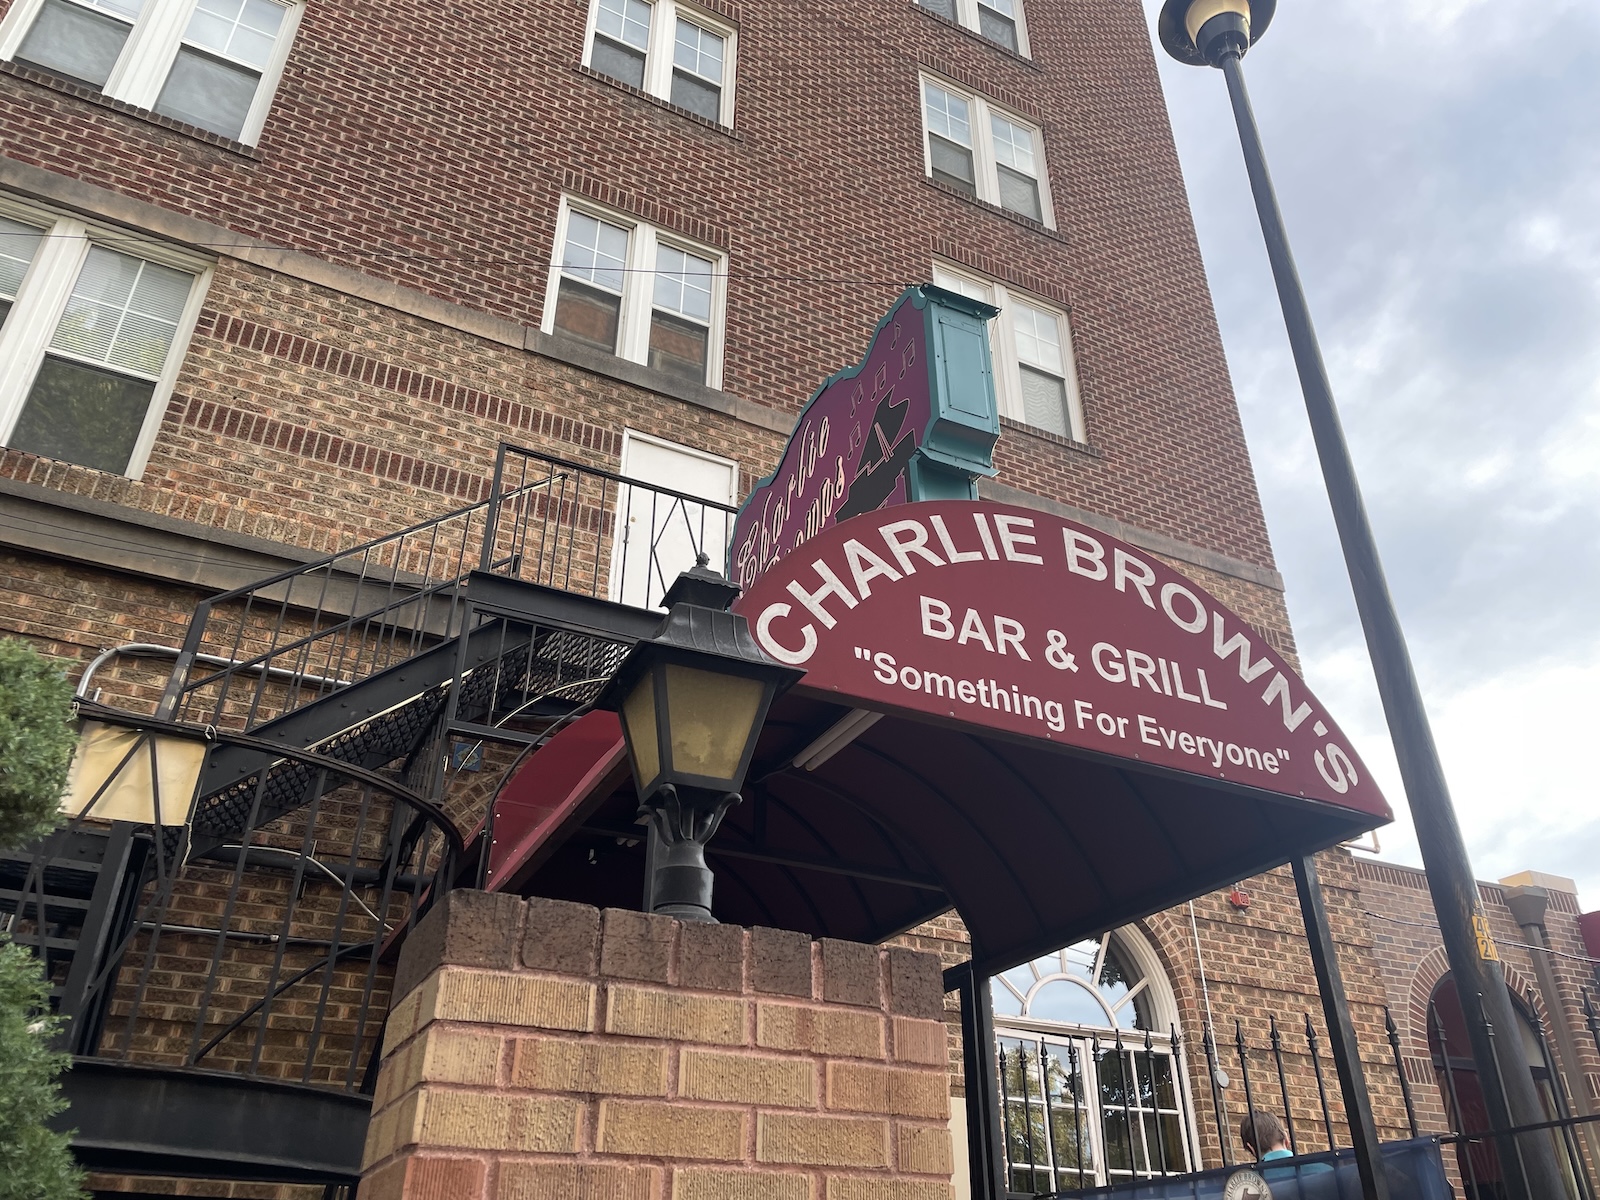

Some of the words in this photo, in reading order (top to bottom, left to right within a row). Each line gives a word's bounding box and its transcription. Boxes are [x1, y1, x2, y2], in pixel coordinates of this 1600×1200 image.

[737, 416, 831, 600] Charlie
[755, 512, 1045, 666] CHARLIE
[1061, 526, 1359, 795] BROWN'S
[854, 646, 1066, 733] "Something
[1073, 699, 1130, 739] For
[1137, 713, 1291, 775] Everyone"
[919, 595, 1032, 662] BAR
[1044, 629, 1080, 674] &
[1091, 641, 1228, 711] GRILL
